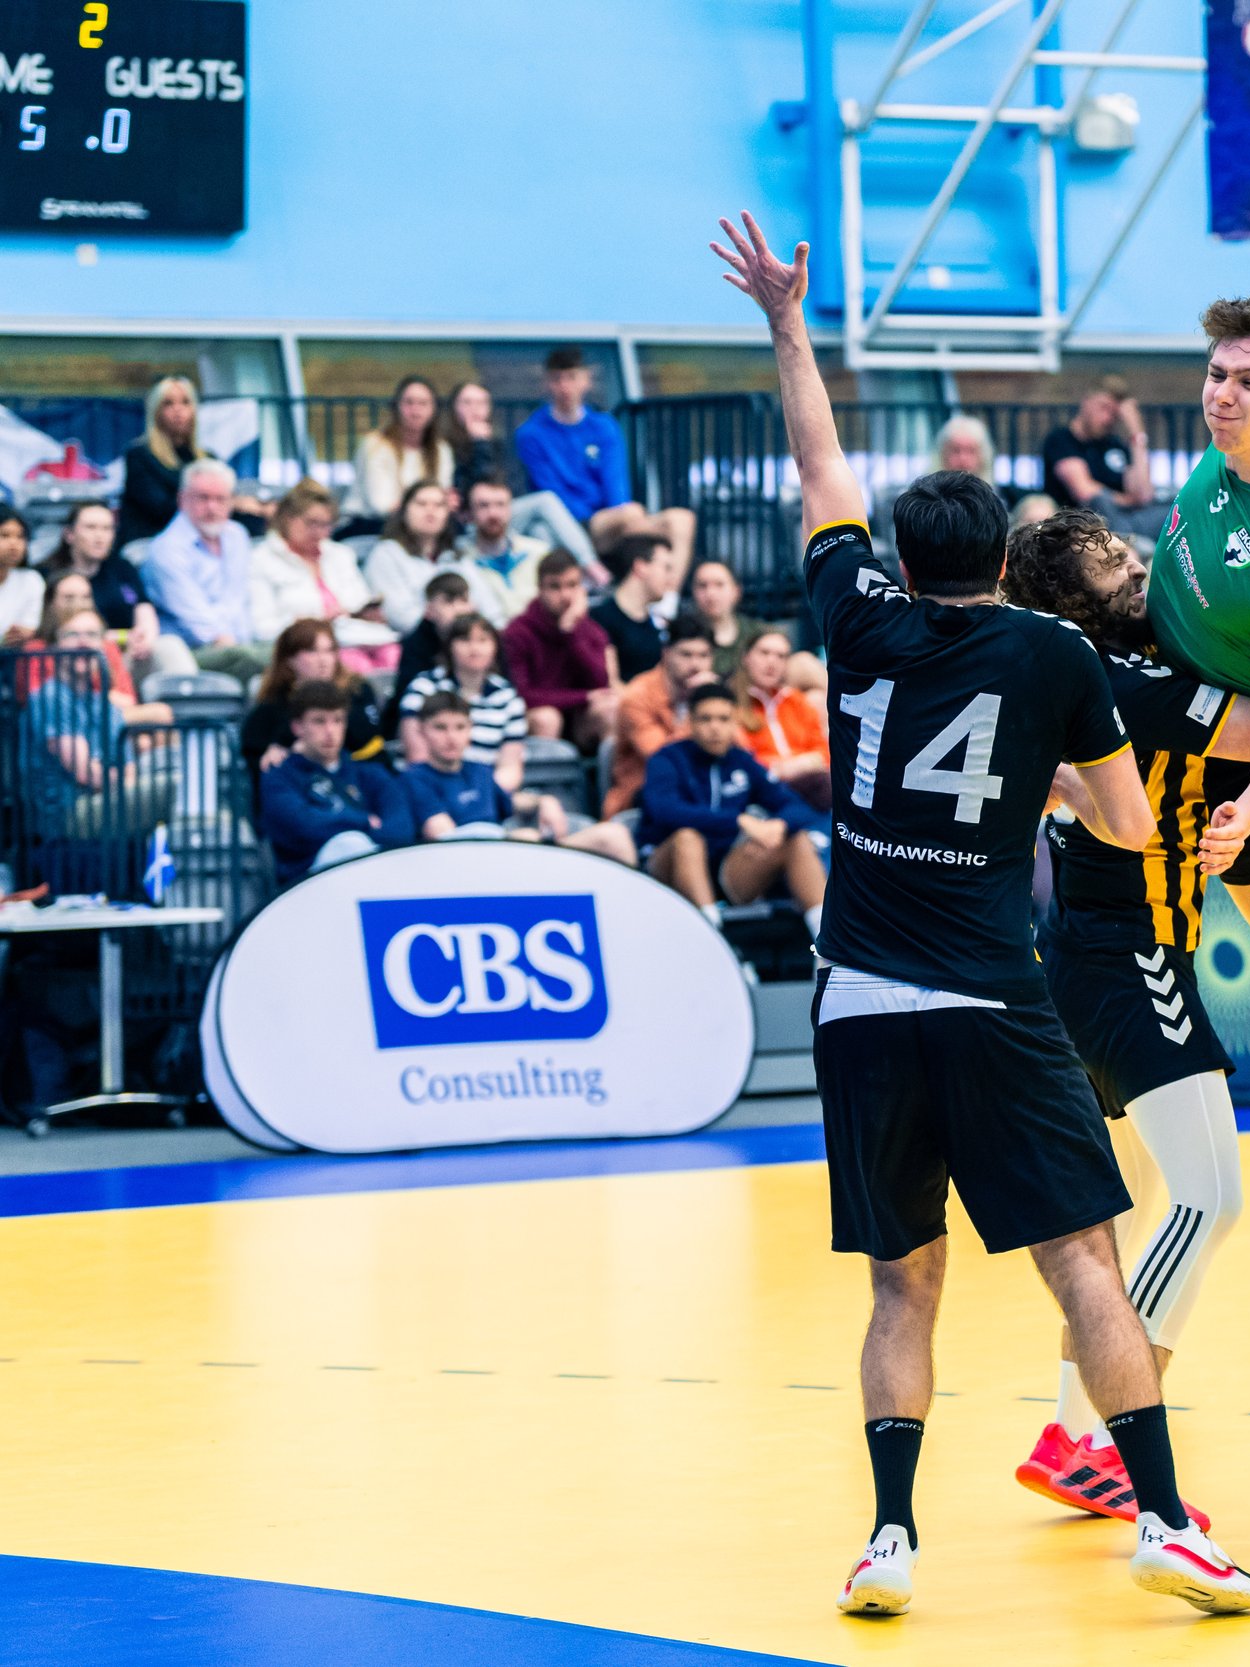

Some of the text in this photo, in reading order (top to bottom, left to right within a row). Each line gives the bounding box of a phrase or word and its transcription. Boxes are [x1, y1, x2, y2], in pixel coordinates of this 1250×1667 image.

[78, 2, 109, 49] 2
[105, 55, 244, 101] GUESTS
[19, 105, 47, 151] 5
[839, 678, 1004, 824] 14
[382, 917, 595, 1018] CBS
[400, 1058, 608, 1107] Consulting
